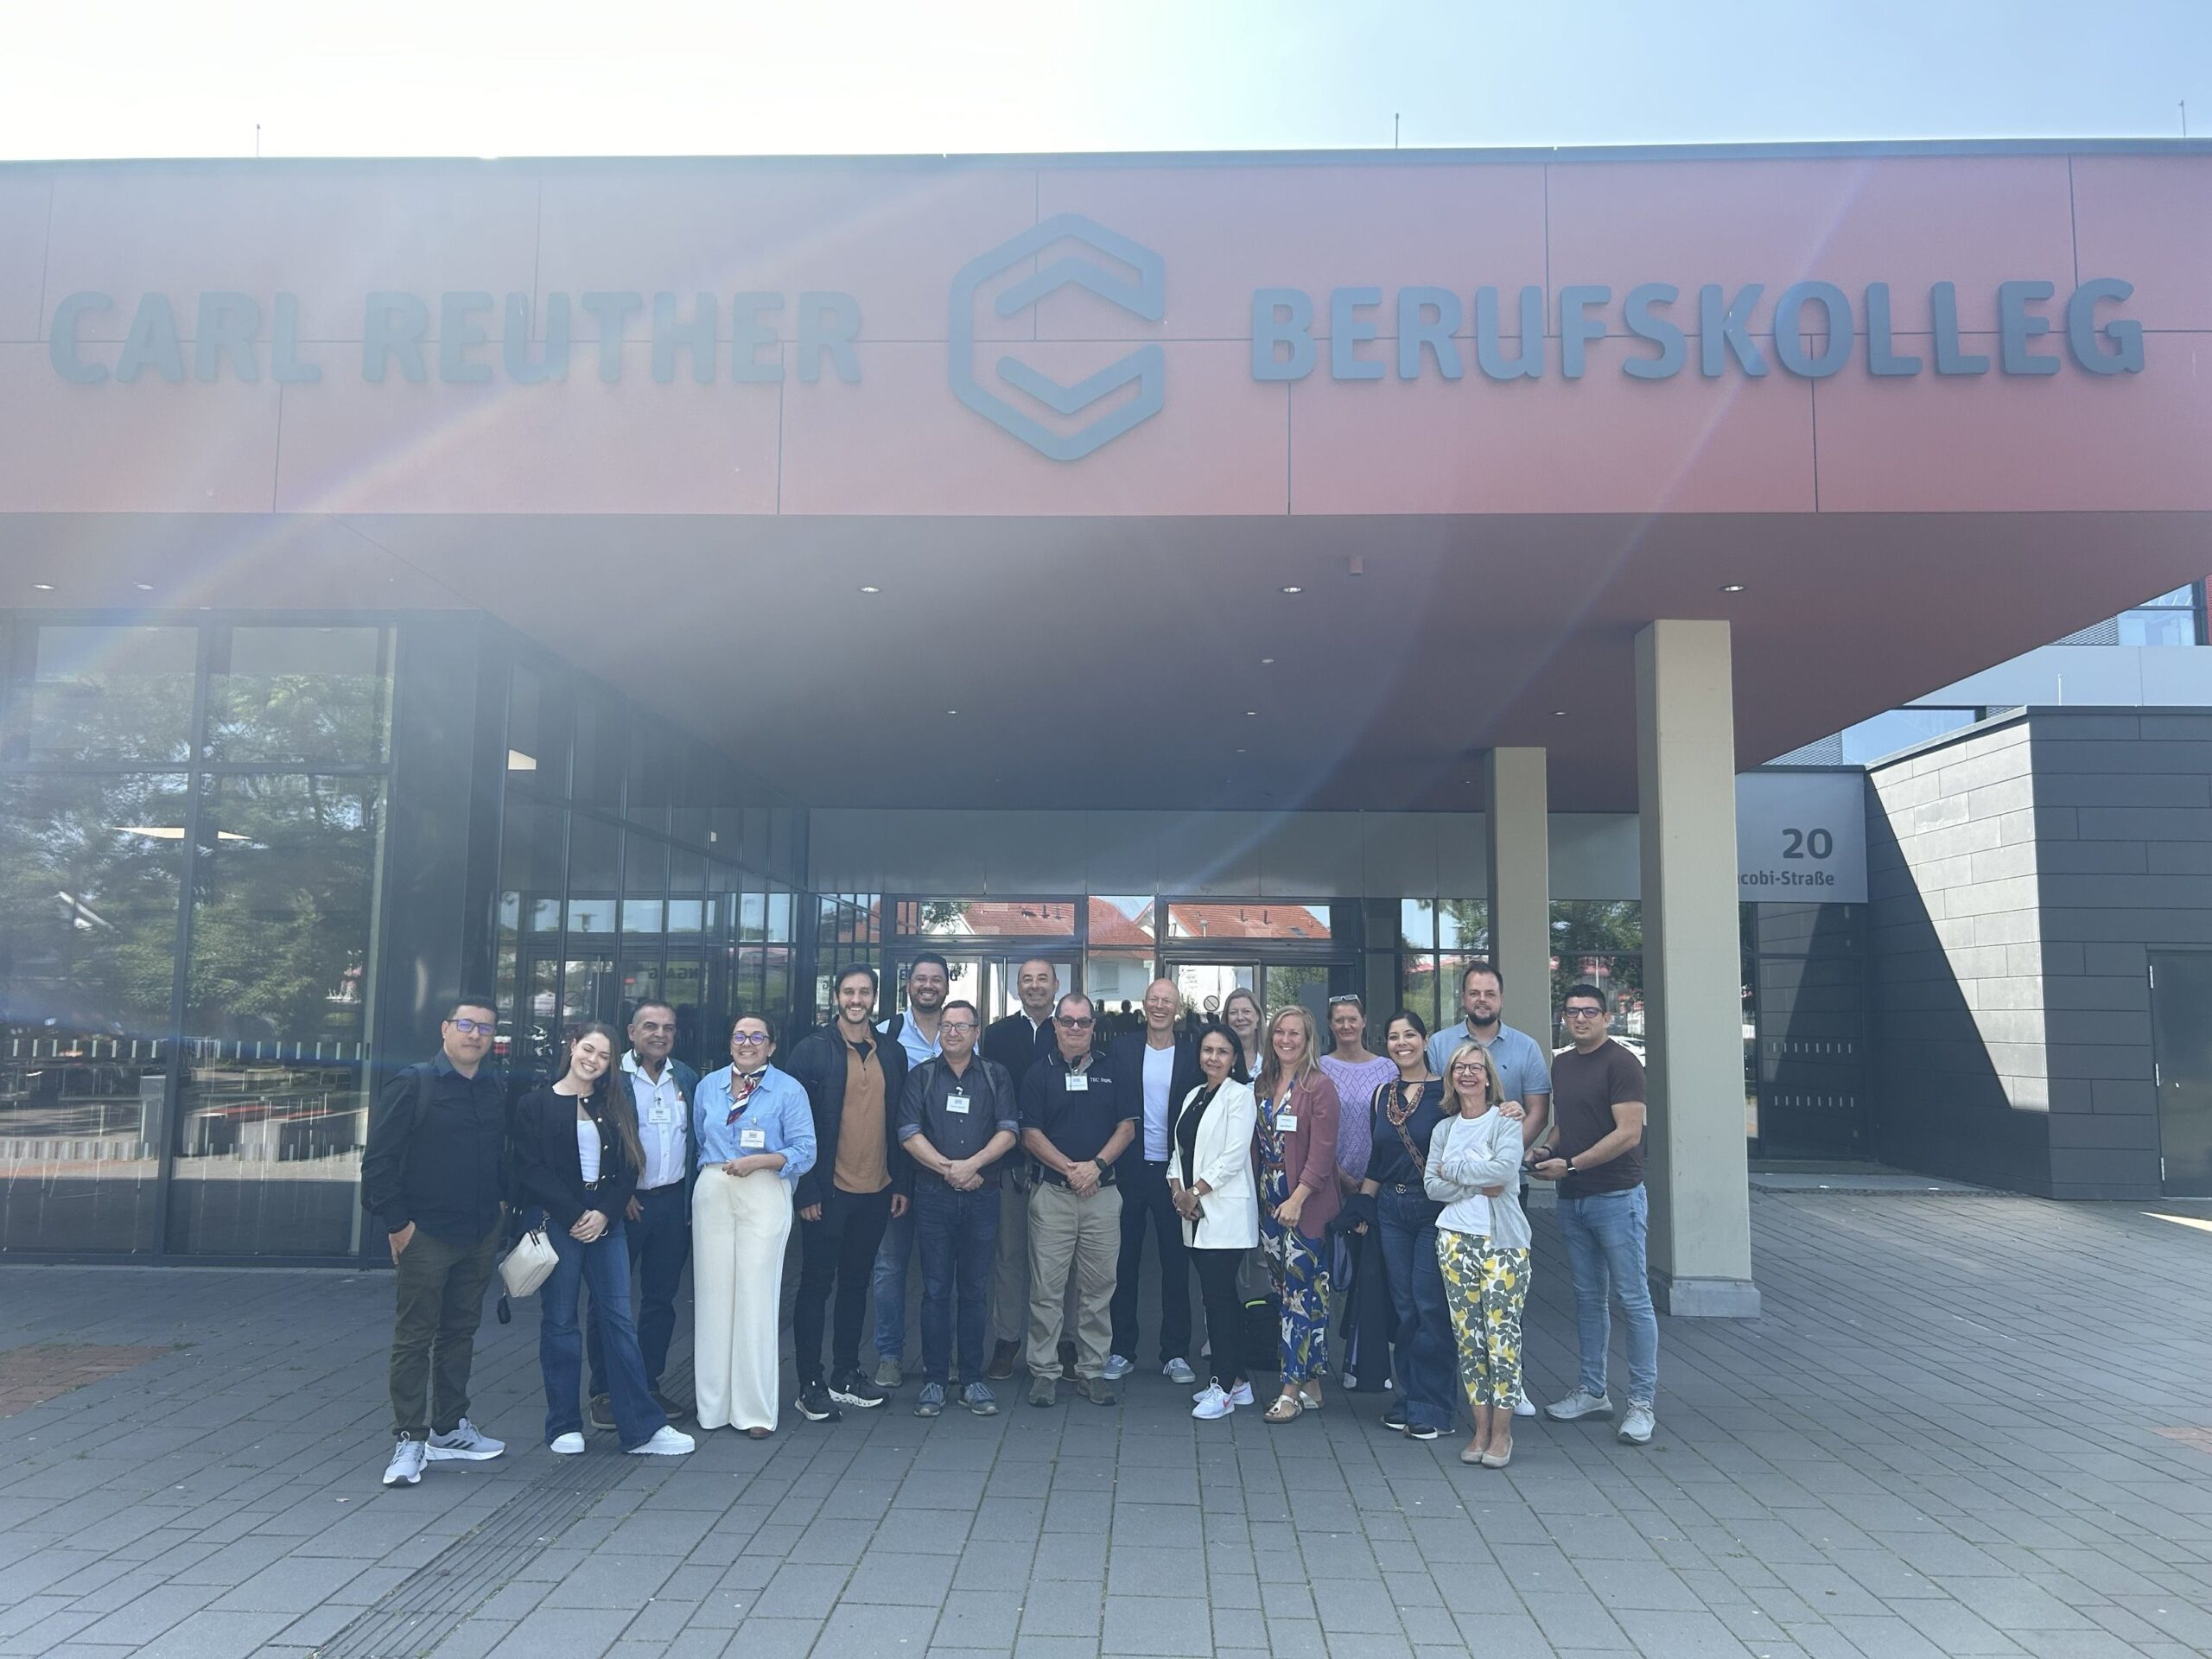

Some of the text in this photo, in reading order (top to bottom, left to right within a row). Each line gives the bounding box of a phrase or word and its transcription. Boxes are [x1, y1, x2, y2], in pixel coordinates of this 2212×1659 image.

[49, 277, 2145, 384] CARL REUTHER BERUFSKOLLEG
[1782, 828, 1834, 859] 20
